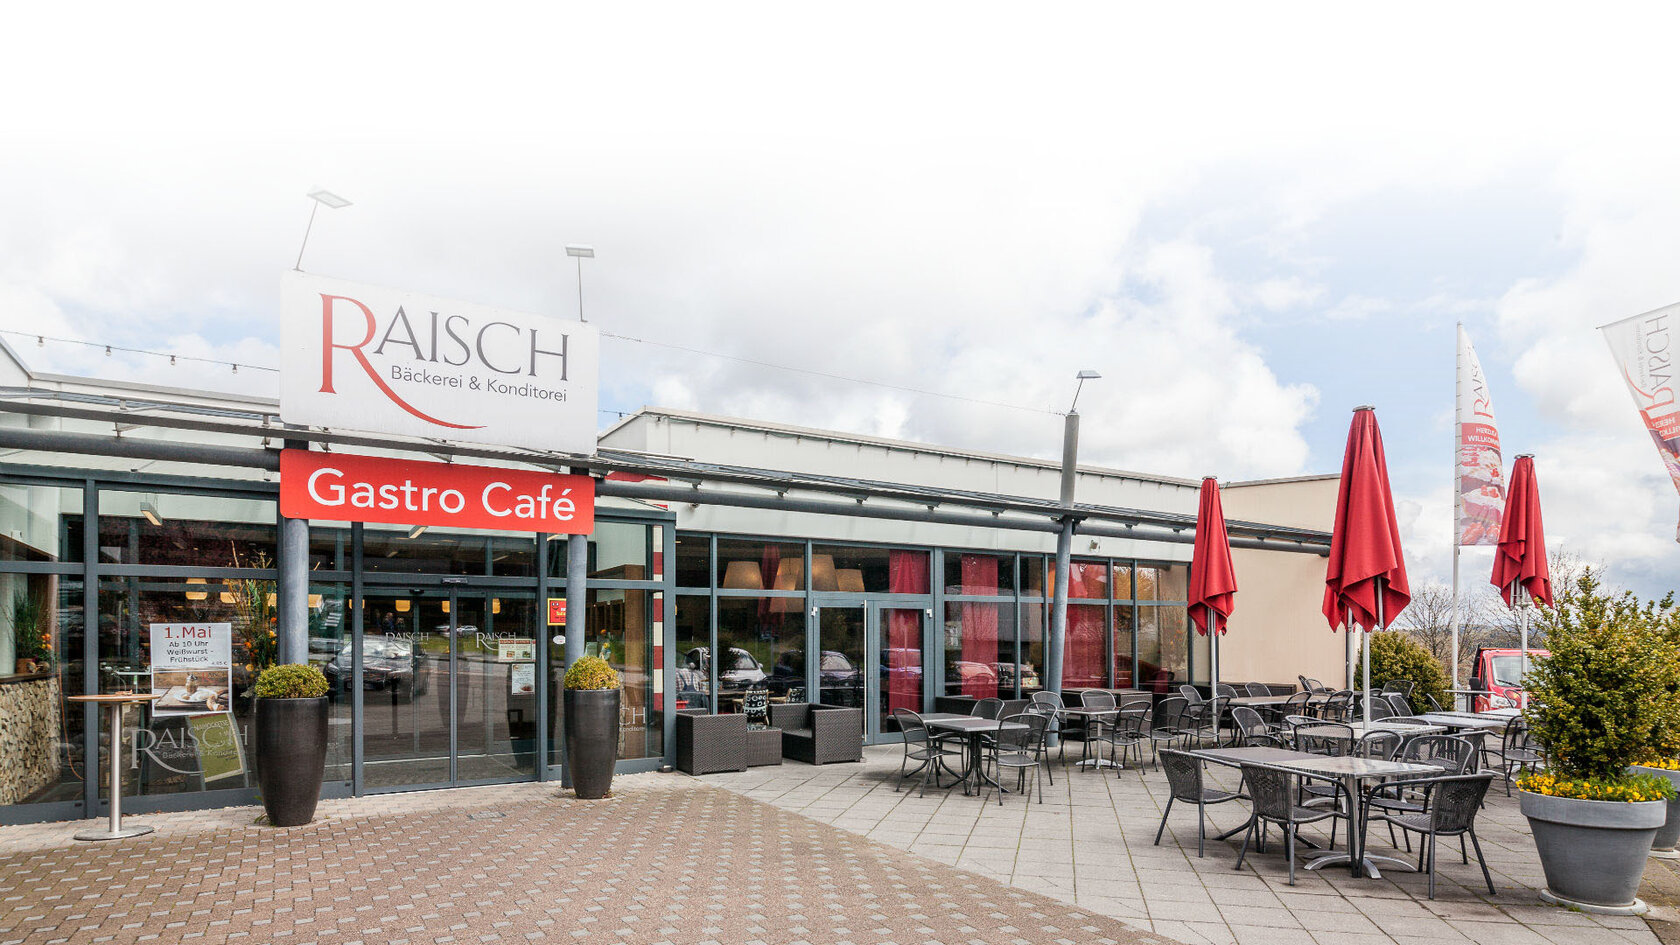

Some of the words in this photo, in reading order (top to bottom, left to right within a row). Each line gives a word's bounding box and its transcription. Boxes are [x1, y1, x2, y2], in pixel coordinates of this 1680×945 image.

[318, 293, 569, 429] RAISCH
[1467, 345, 1493, 419] RAIS
[391, 365, 463, 389] Bäckerei
[469, 376, 481, 390] &
[486, 378, 567, 402] Konditorei
[307, 467, 466, 515] Gastro
[481, 481, 576, 522] Café
[166, 648, 208, 656] Weißwurst
[182, 640, 193, 648] 10
[476, 631, 517, 650] RAISCH
[129, 724, 248, 774] RAISCH
